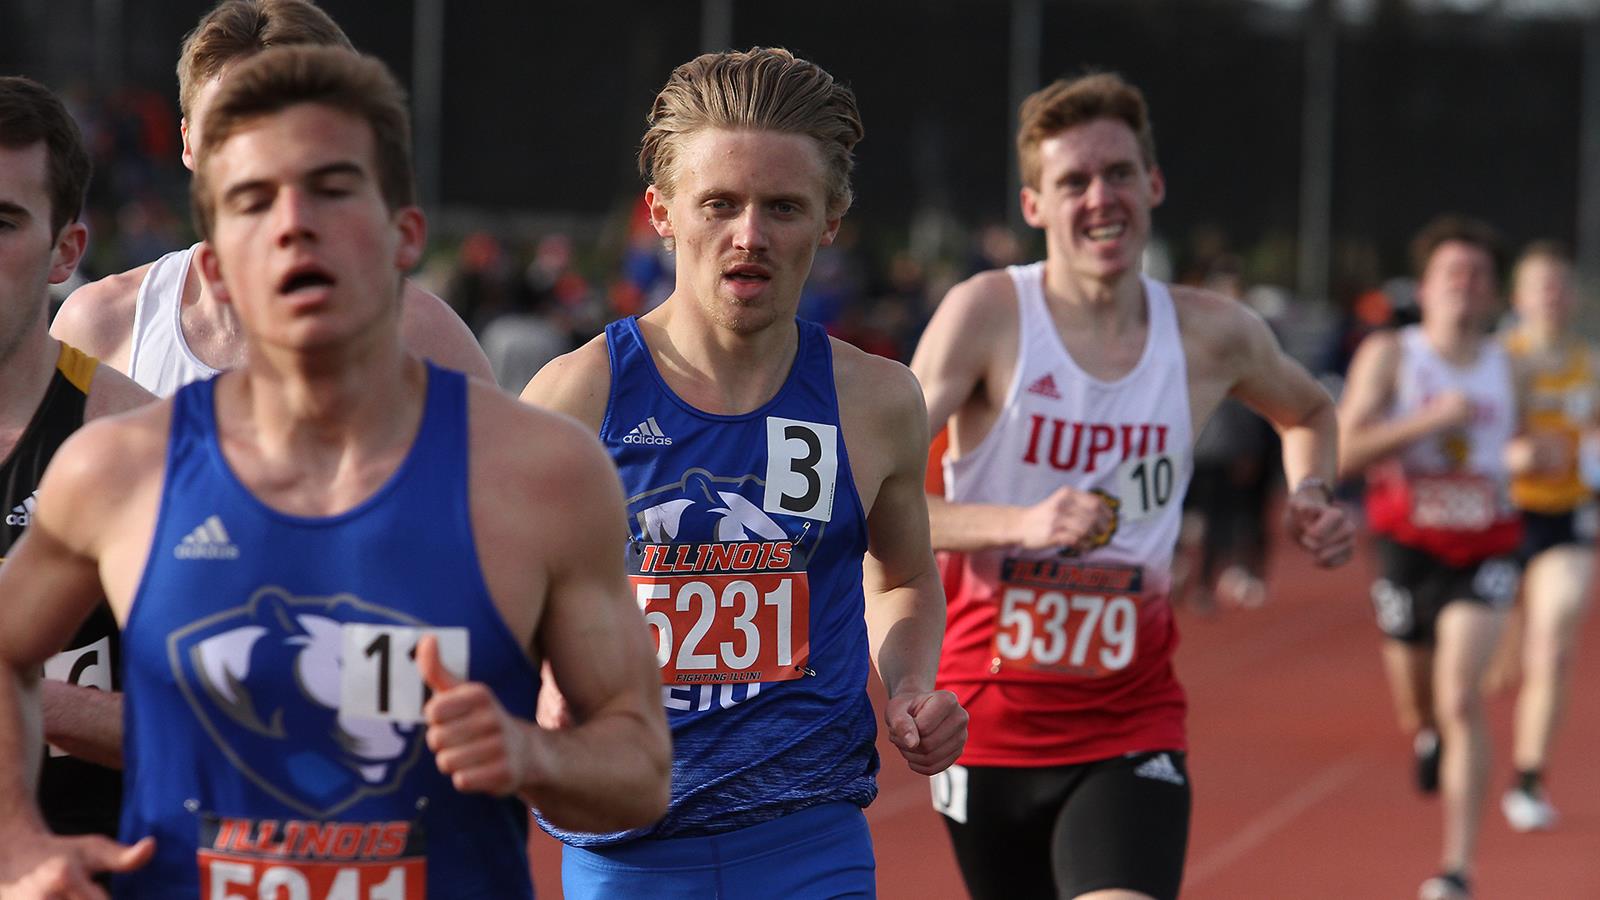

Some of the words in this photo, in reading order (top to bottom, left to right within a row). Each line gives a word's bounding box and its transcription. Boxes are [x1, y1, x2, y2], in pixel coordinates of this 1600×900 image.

[622, 433, 673, 446] adidas
[779, 425, 823, 512] 3
[1131, 457, 1174, 513] 10
[639, 541, 794, 573] ILLINOIS
[635, 577, 794, 671] 5231
[996, 587, 1137, 672] 5379
[364, 632, 434, 714] 1
[675, 673, 728, 682] FIGHTING
[729, 671, 761, 681] ILLINI
[213, 818, 411, 858] ILLINOIS
